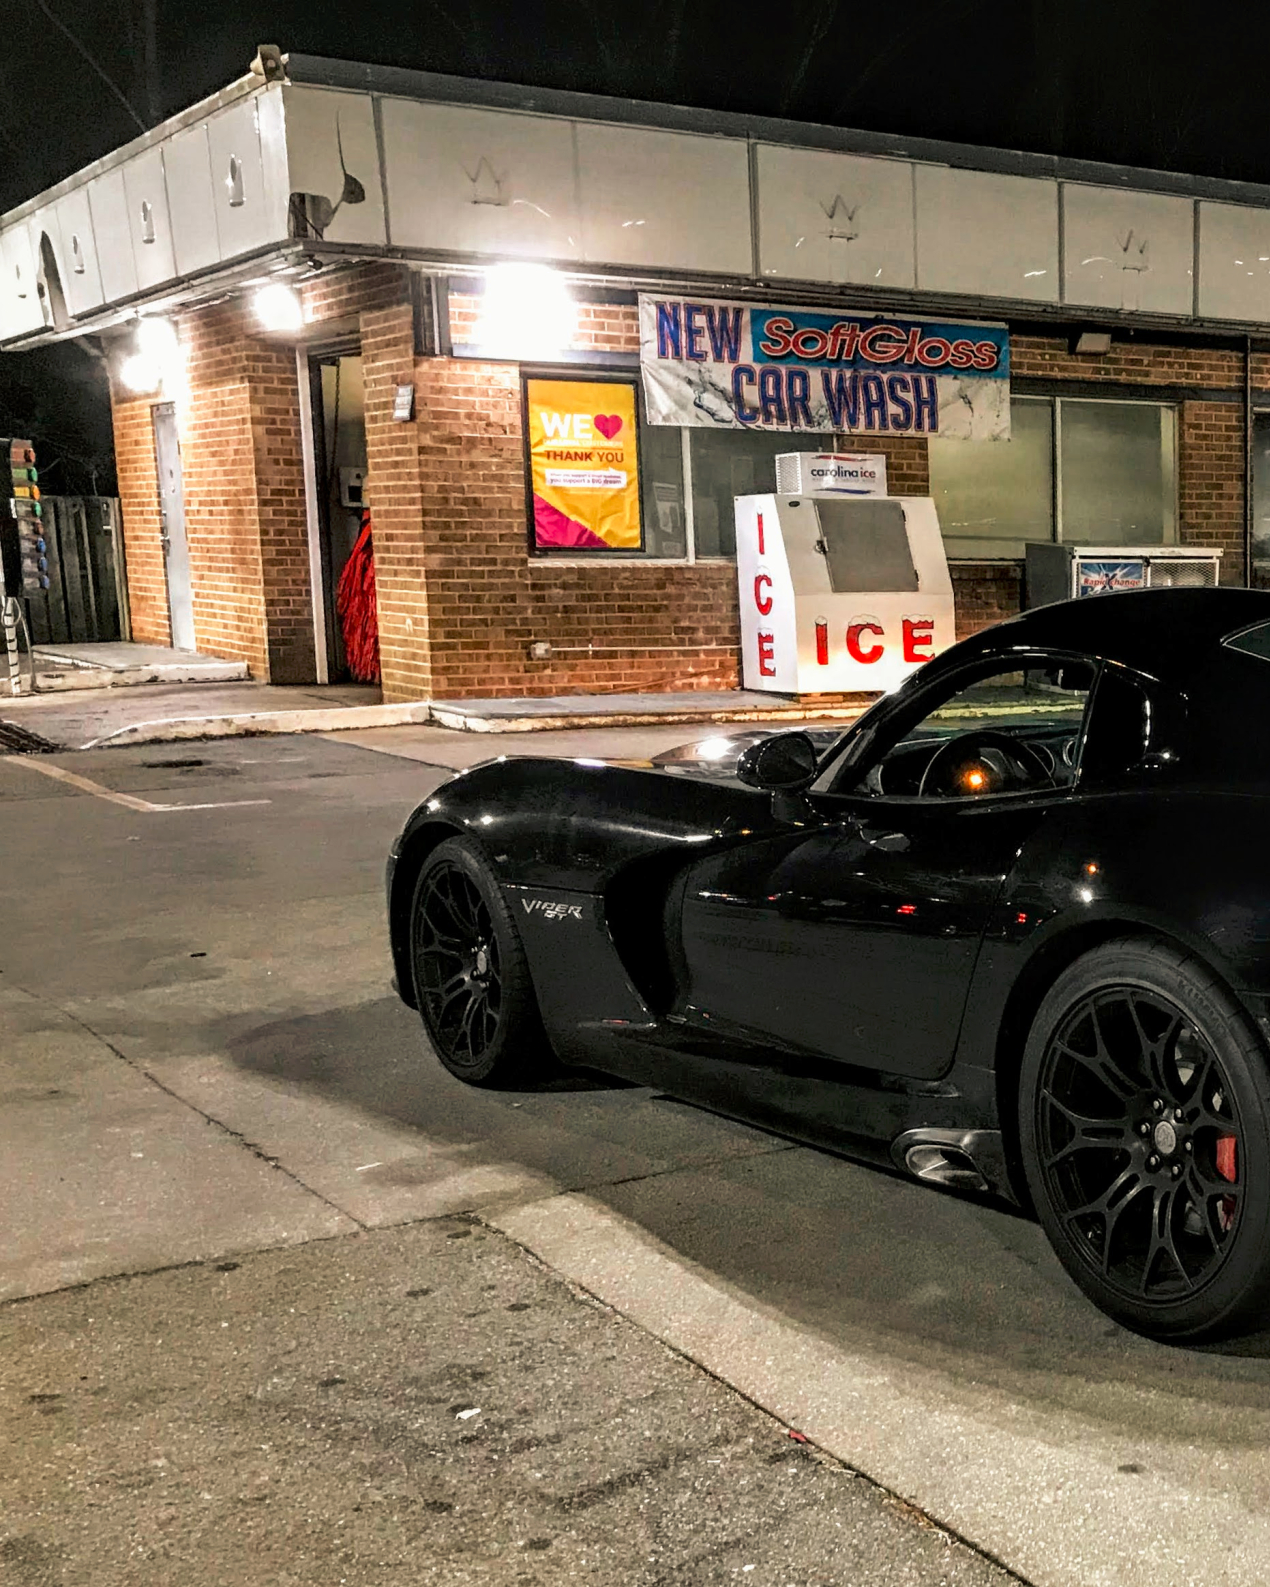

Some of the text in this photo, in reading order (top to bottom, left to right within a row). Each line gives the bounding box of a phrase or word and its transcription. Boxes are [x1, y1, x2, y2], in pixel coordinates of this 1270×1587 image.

[655, 301, 999, 369] NEW SoftGloss
[731, 364, 938, 433] CAR WASH
[540, 412, 593, 439] WE
[544, 450, 624, 463] THANK YOU
[811, 465, 876, 479] carolina ice
[754, 509, 777, 677] ICE
[815, 614, 937, 665] ICE
[521, 898, 583, 919] VIPER
